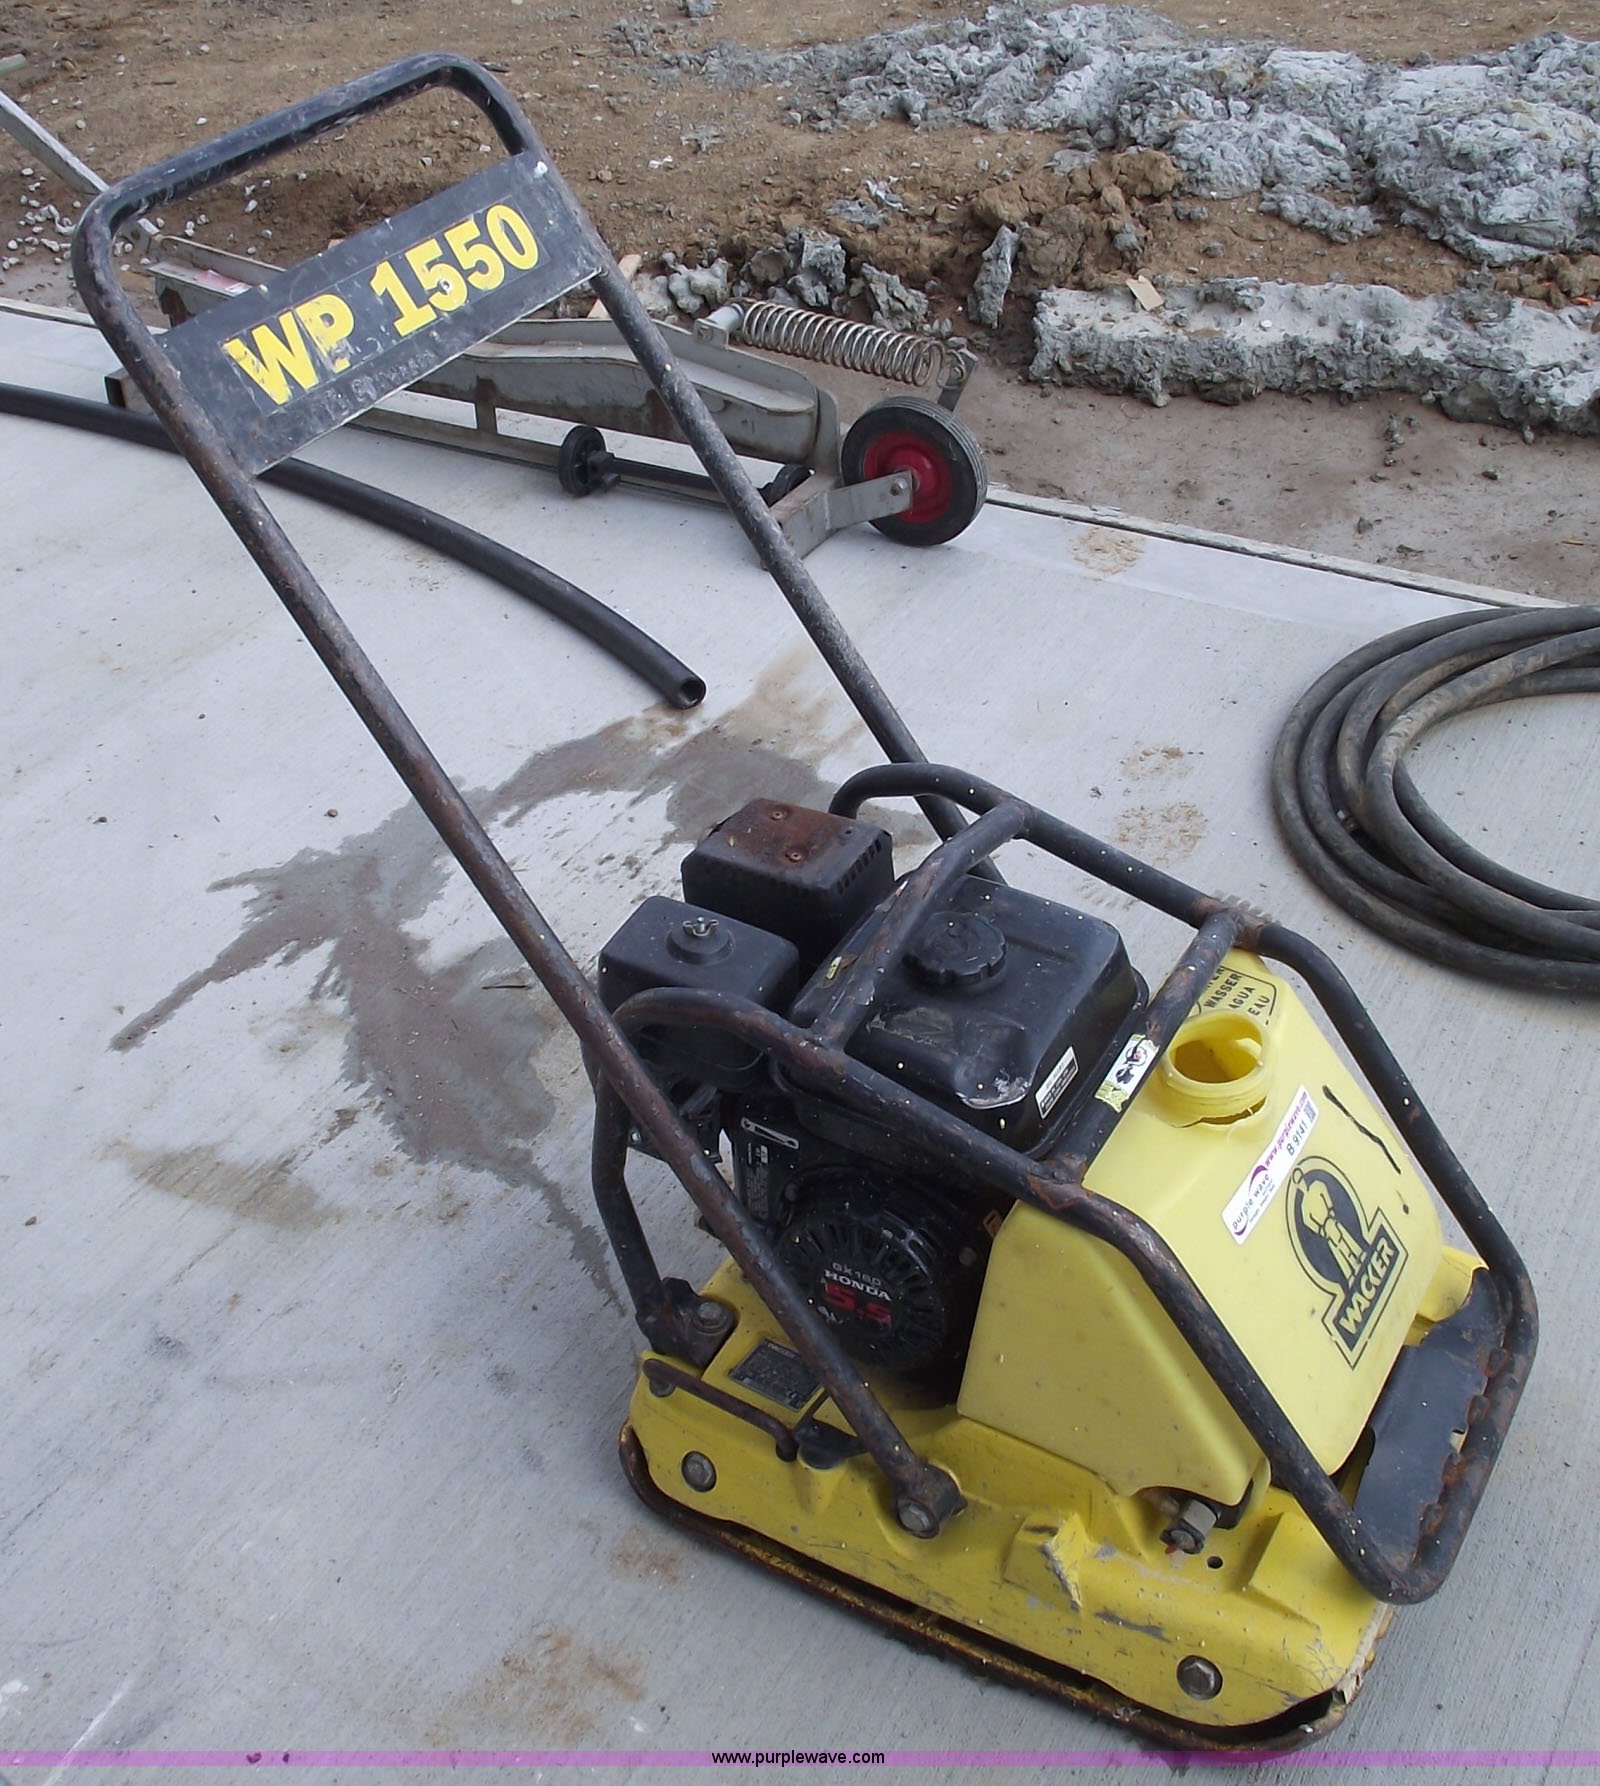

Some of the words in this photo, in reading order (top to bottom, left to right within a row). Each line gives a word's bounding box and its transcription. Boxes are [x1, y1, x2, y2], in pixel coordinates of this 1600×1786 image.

[223, 293, 355, 406] WP
[369, 204, 540, 337] 1550
[1203, 973, 1242, 1008] WASSER
[1228, 987, 1256, 1009] AGUA
[1247, 995, 1271, 1016] EAU
[1264, 1091, 1308, 1168] www.purplewave.com
[1232, 1198, 1254, 1230] purple
[1253, 1173, 1271, 1199] wave
[824, 1269, 892, 1302] HONDA
[1338, 1236, 1395, 1335] WACKER
